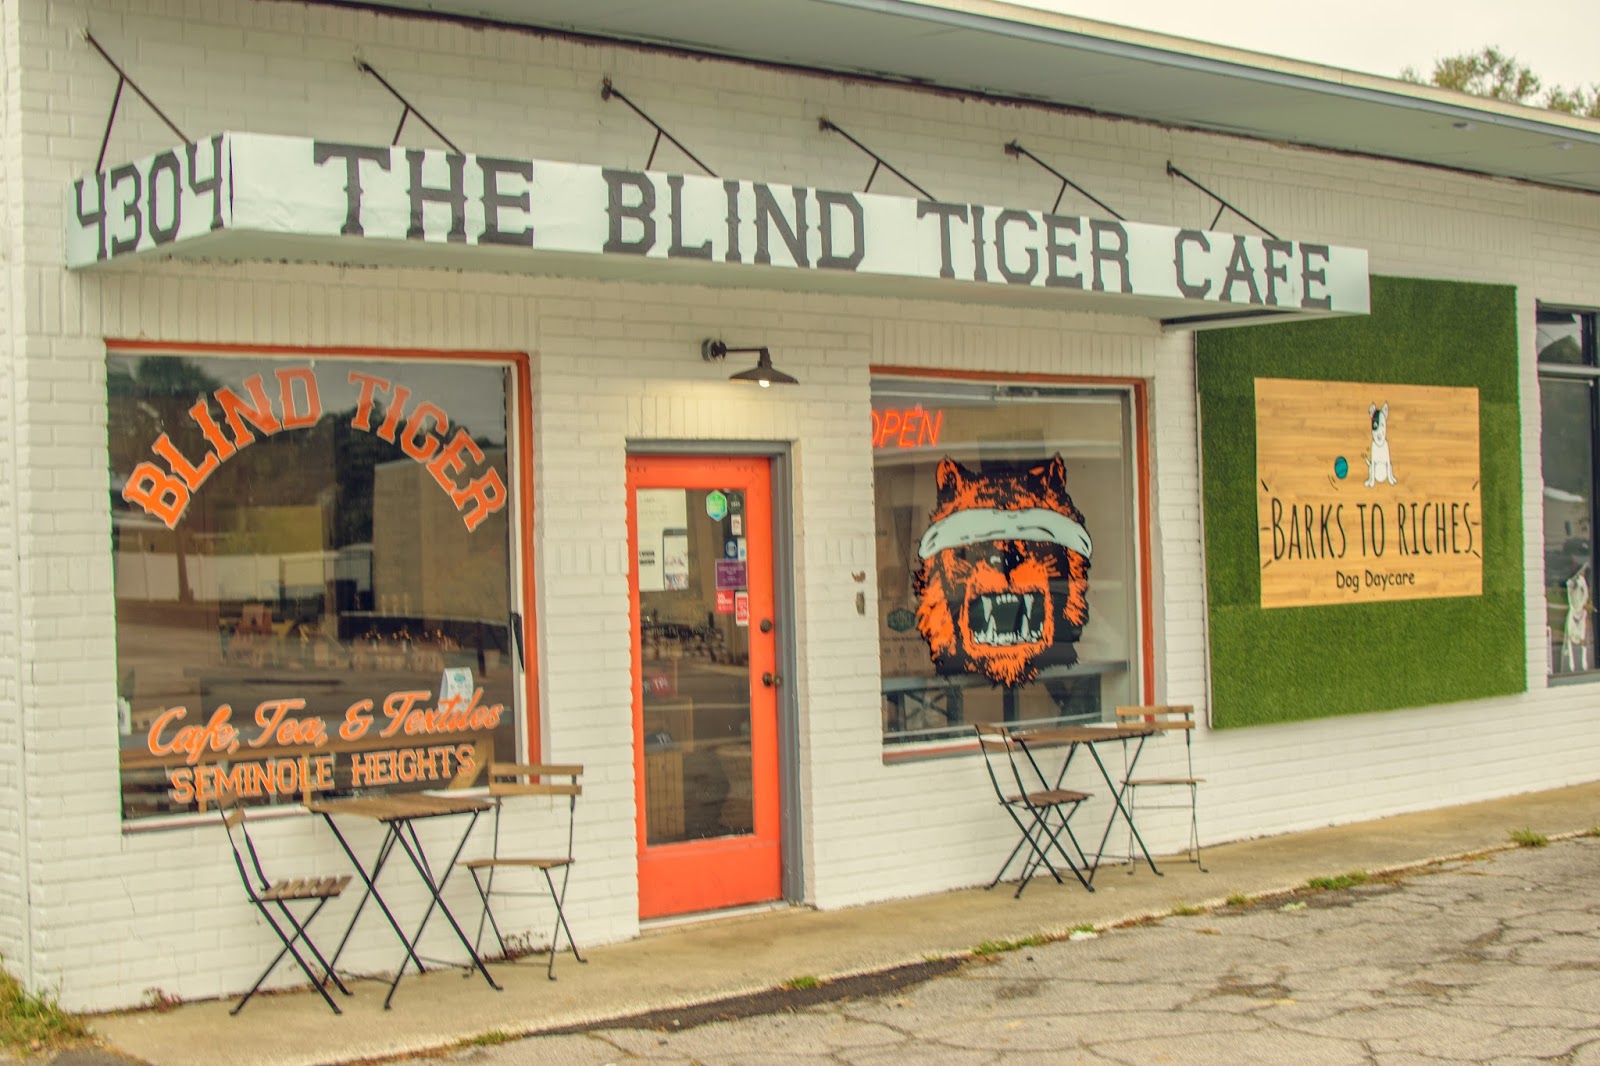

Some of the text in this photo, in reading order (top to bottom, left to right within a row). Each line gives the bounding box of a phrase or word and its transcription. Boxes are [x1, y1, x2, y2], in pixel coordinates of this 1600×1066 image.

[74, 131, 226, 260] 4304
[313, 143, 1332, 310] THE BLIND TIGER CAFE
[122, 367, 508, 534] BLIND TIGER
[1271, 497, 1473, 561] BARKS TO RICHES
[1335, 568, 1416, 593] Dog Daycare
[248, 697, 328, 748] Tea,
[338, 699, 375, 741] &
[379, 686, 504, 739] Textiles
[168, 743, 477, 804] SEMINOLE HEIGHTS
